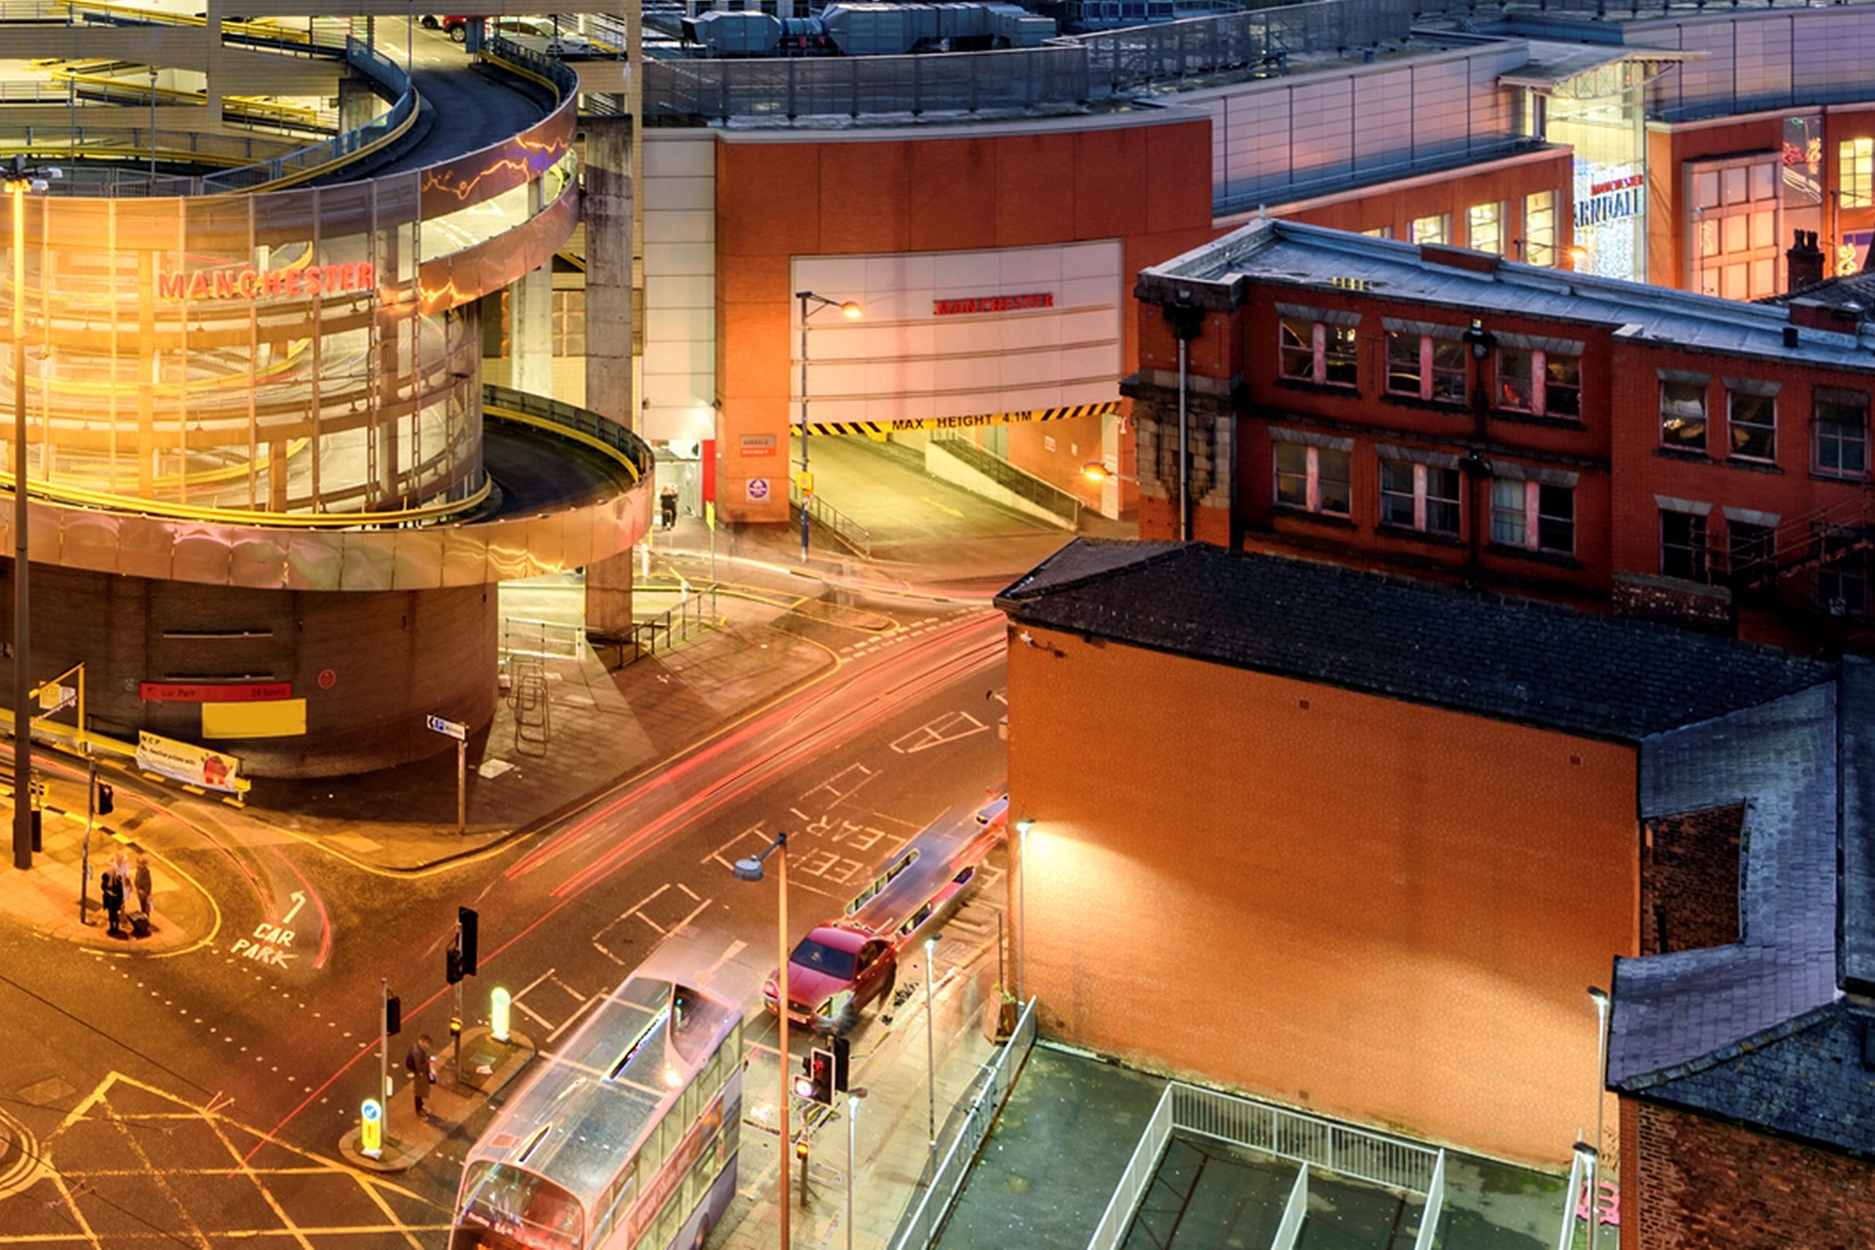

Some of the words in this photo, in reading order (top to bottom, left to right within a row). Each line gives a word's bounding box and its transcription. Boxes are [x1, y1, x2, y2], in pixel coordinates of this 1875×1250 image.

[157, 261, 375, 299] MANCHESTER
[933, 292, 1054, 316] MANCHESTER
[892, 419, 924, 430] MAX
[937, 414, 993, 428] HEIGHT
[1002, 411, 1033, 422] 4.1M
[806, 815, 908, 851] LEAR
[253, 922, 296, 948] CAR
[230, 938, 299, 970] PARK
